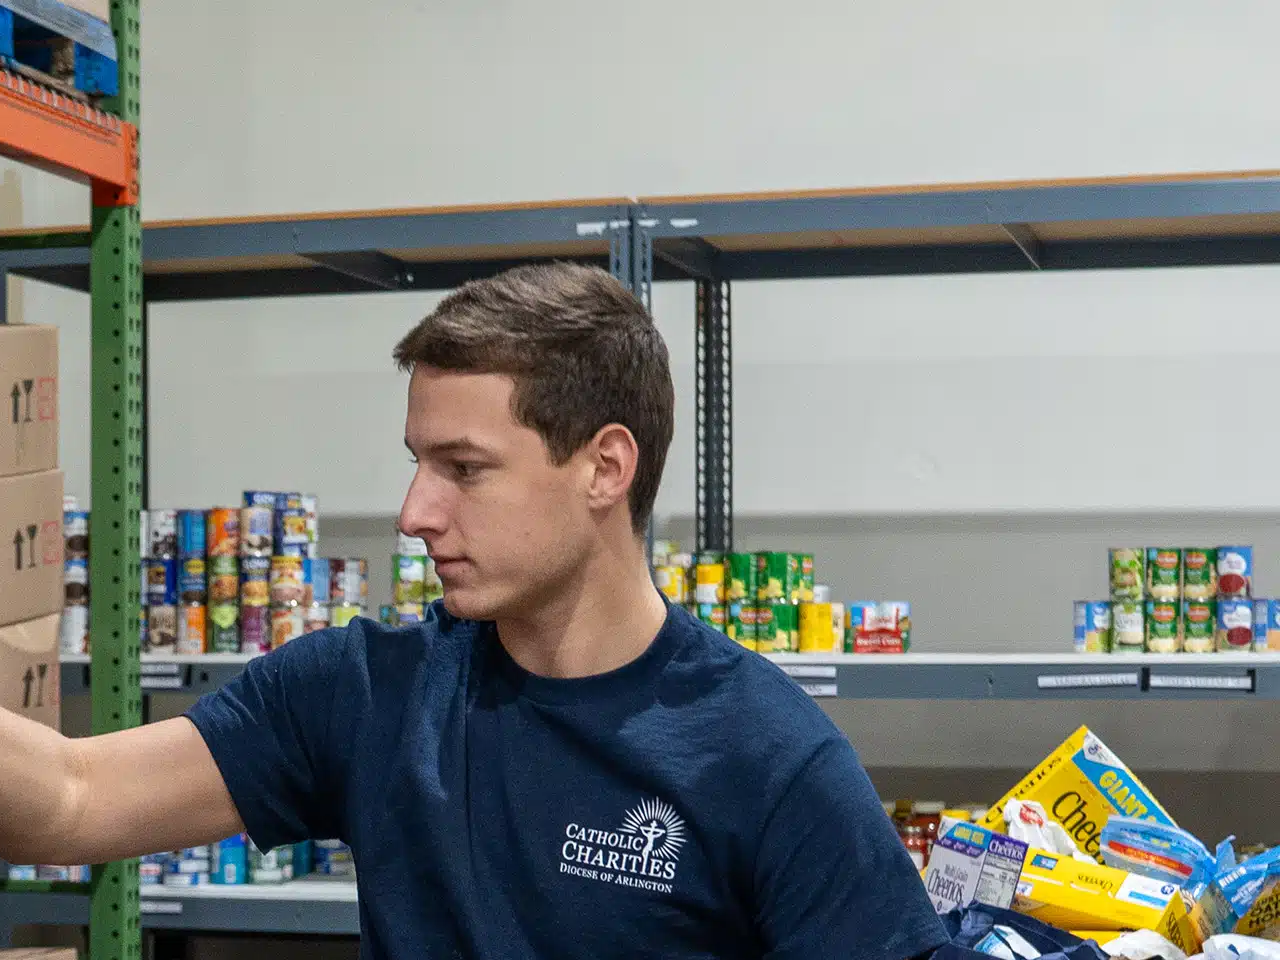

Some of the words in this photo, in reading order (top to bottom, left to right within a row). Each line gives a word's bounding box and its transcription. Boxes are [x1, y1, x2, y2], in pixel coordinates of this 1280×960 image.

[1099, 770, 1148, 819] GIANT
[565, 823, 644, 851] CATHOLIC
[560, 862, 598, 880] DIOCESE
[599, 871, 614, 882] OF
[614, 874, 673, 894] ARLINGTON
[562, 840, 676, 880] CHARITIES
